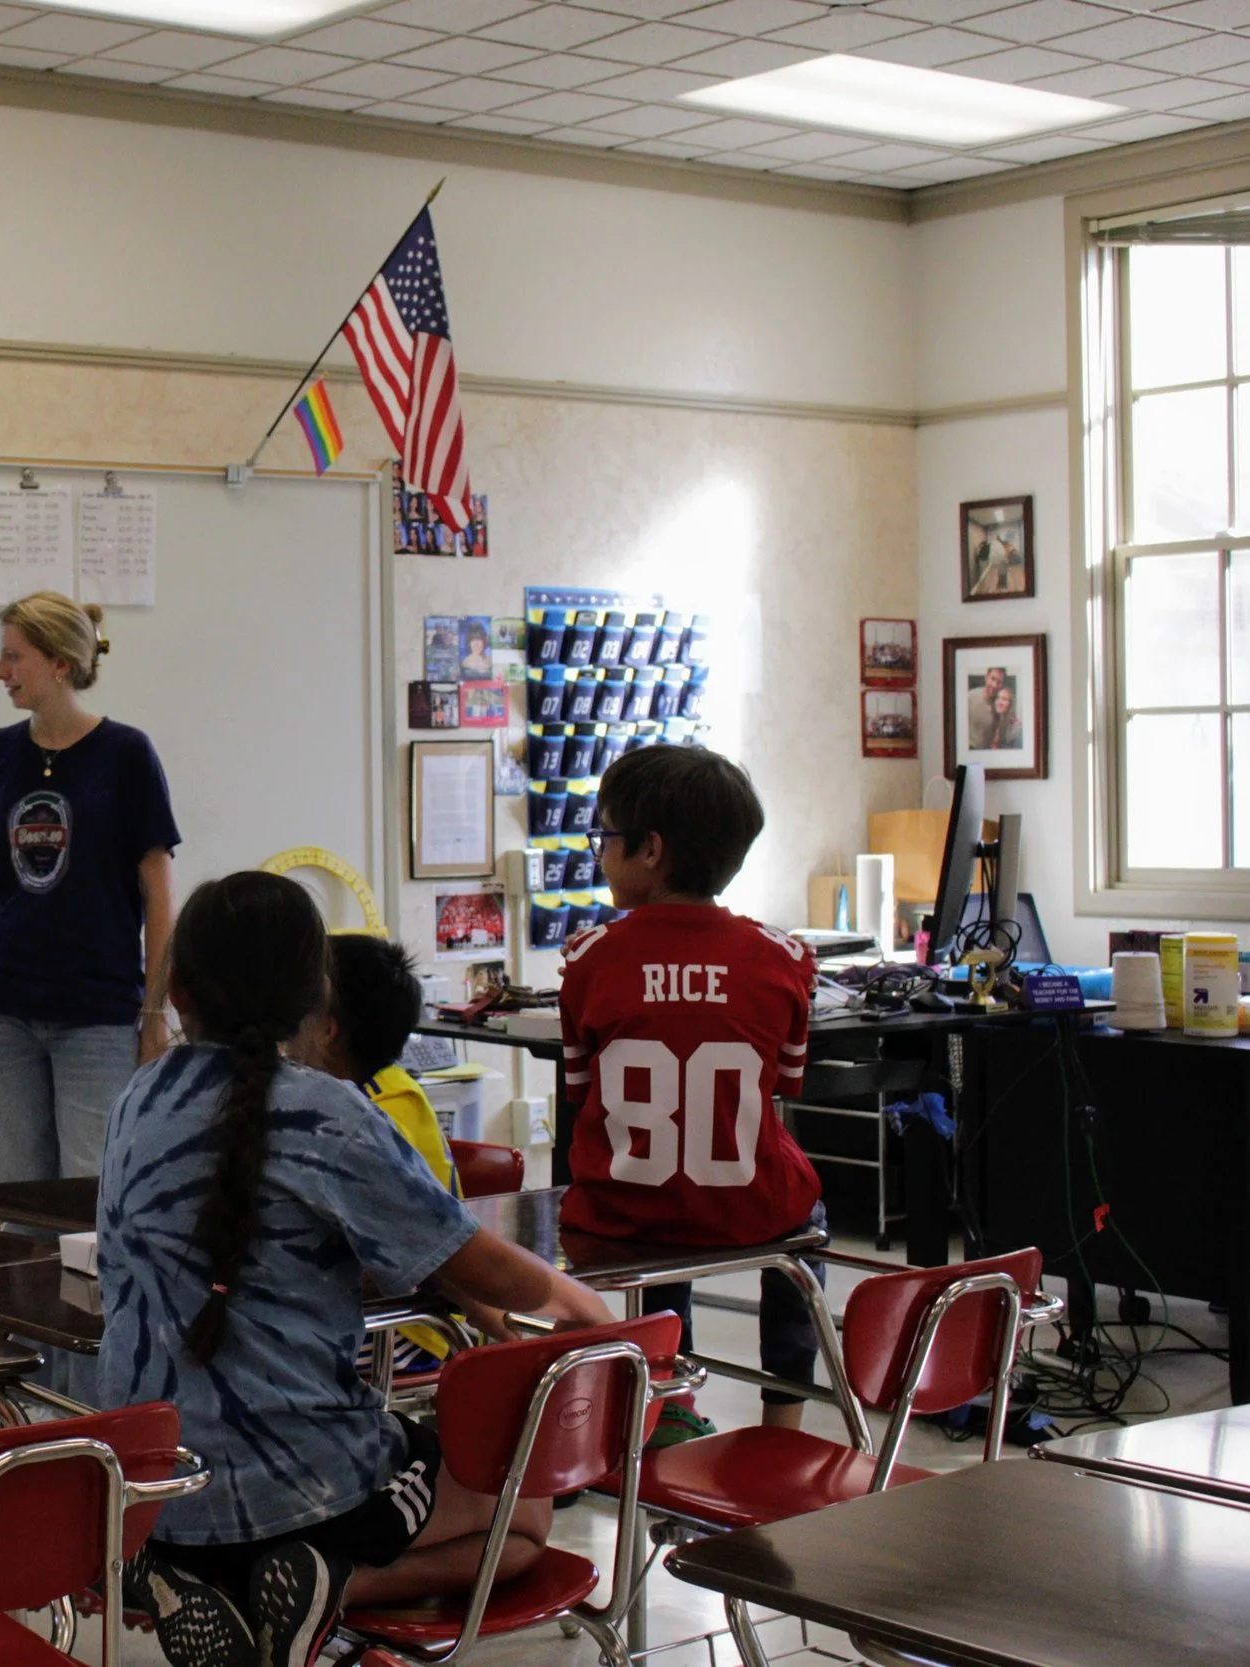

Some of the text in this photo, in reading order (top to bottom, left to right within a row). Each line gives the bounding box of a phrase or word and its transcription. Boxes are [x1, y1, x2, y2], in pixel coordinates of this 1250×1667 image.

[541, 640, 557, 658] 01
[572, 640, 590, 658] 02
[601, 640, 620, 659] 03
[541, 696, 560, 715] 07
[573, 696, 592, 715] 08
[602, 696, 620, 715] 09
[664, 696, 680, 715] 11
[542, 751, 559, 770] 13
[574, 751, 589, 769] 14
[545, 808, 562, 827] 19
[574, 806, 593, 825] 20
[545, 863, 564, 882] 25
[574, 862, 593, 880] 26
[546, 920, 562, 940] 31
[642, 963, 728, 1004] RICE
[598, 1038, 764, 1188] 80
